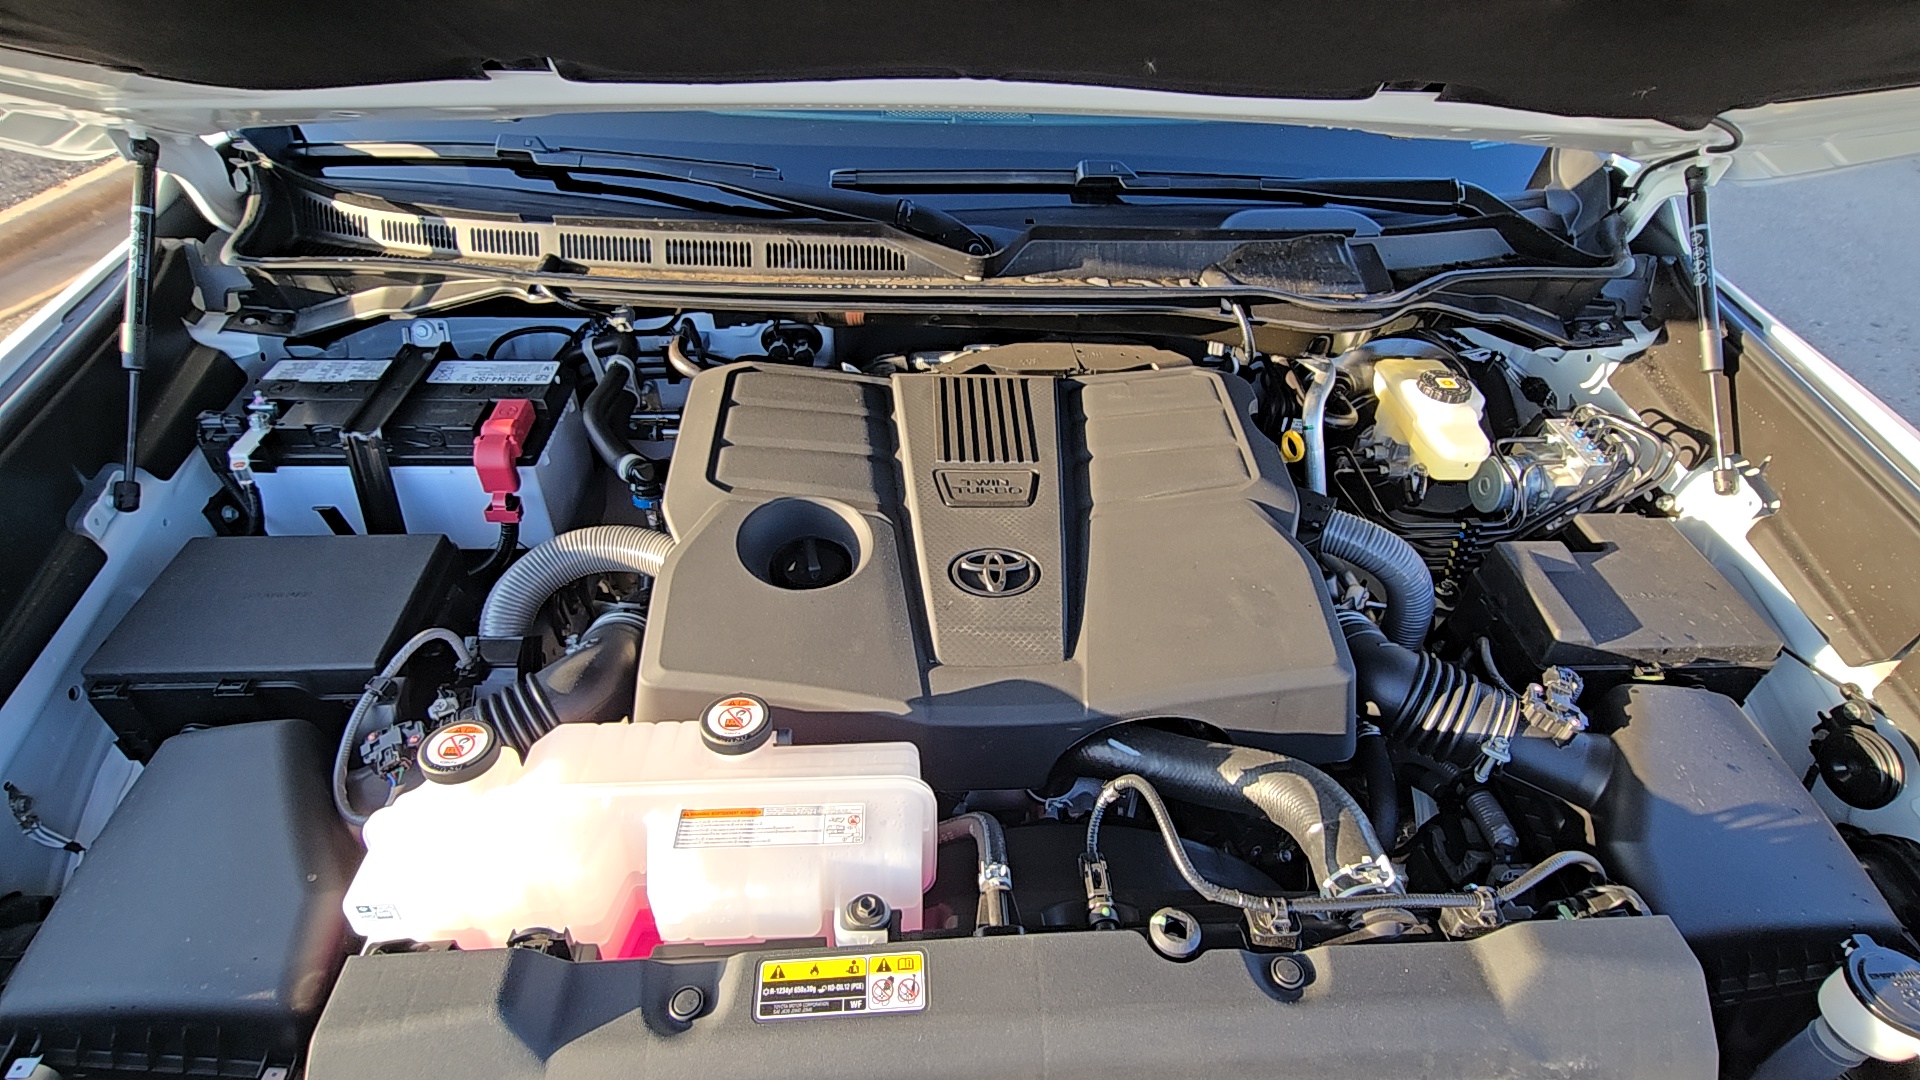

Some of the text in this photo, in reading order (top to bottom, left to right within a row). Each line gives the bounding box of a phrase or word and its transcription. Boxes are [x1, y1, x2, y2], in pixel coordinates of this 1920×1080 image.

[960, 478, 1009, 486] TWIN
[952, 486, 1022, 494] TURBO
[850, 1000, 862, 1008] WF
